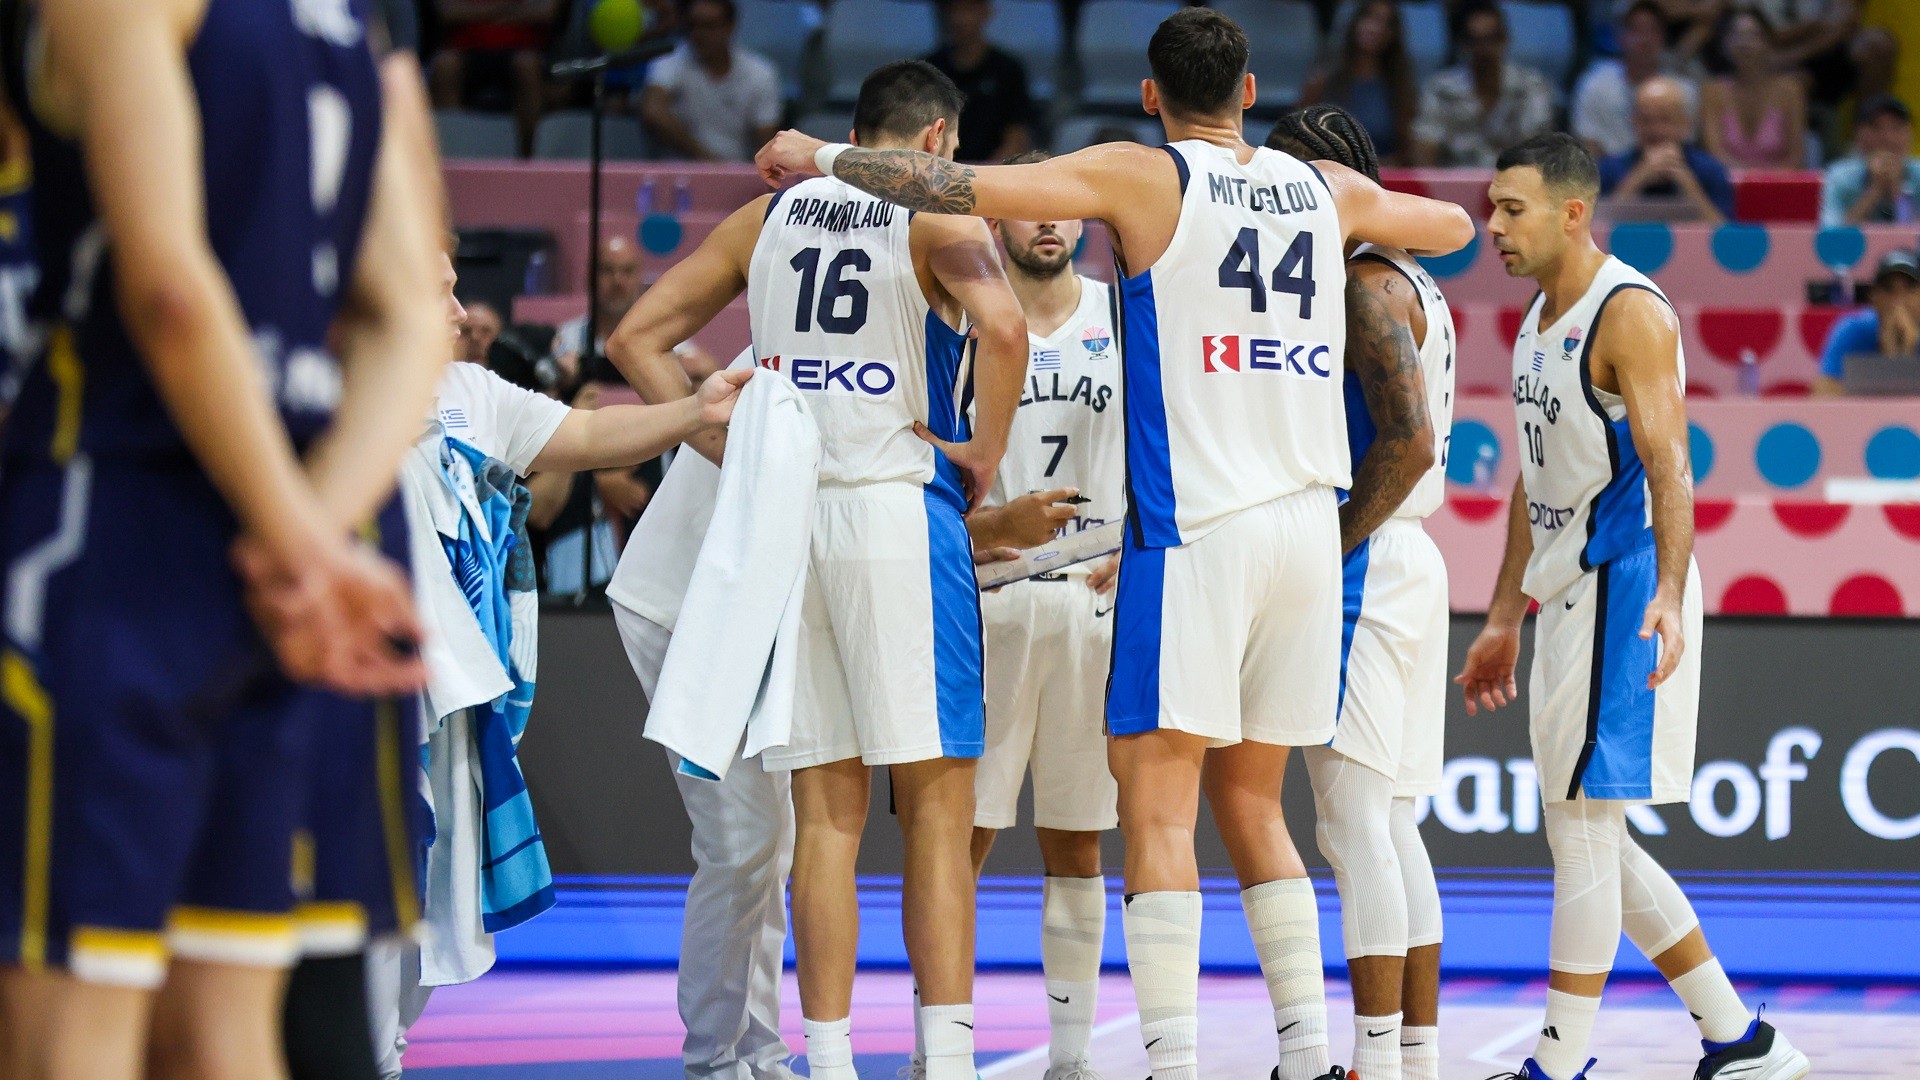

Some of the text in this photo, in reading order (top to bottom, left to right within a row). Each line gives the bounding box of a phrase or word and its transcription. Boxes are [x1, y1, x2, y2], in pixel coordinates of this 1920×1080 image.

[1207, 171, 1318, 215] MITOGLOU
[789, 247, 872, 335] 16
[1218, 227, 1316, 320] 44
[791, 359, 896, 396] EKO
[1250, 338, 1330, 378] EKO
[1018, 372, 1113, 414] LLAS
[1041, 435, 1068, 478] 7
[1524, 421, 1545, 468] 10
[1689, 725, 1823, 841] of
